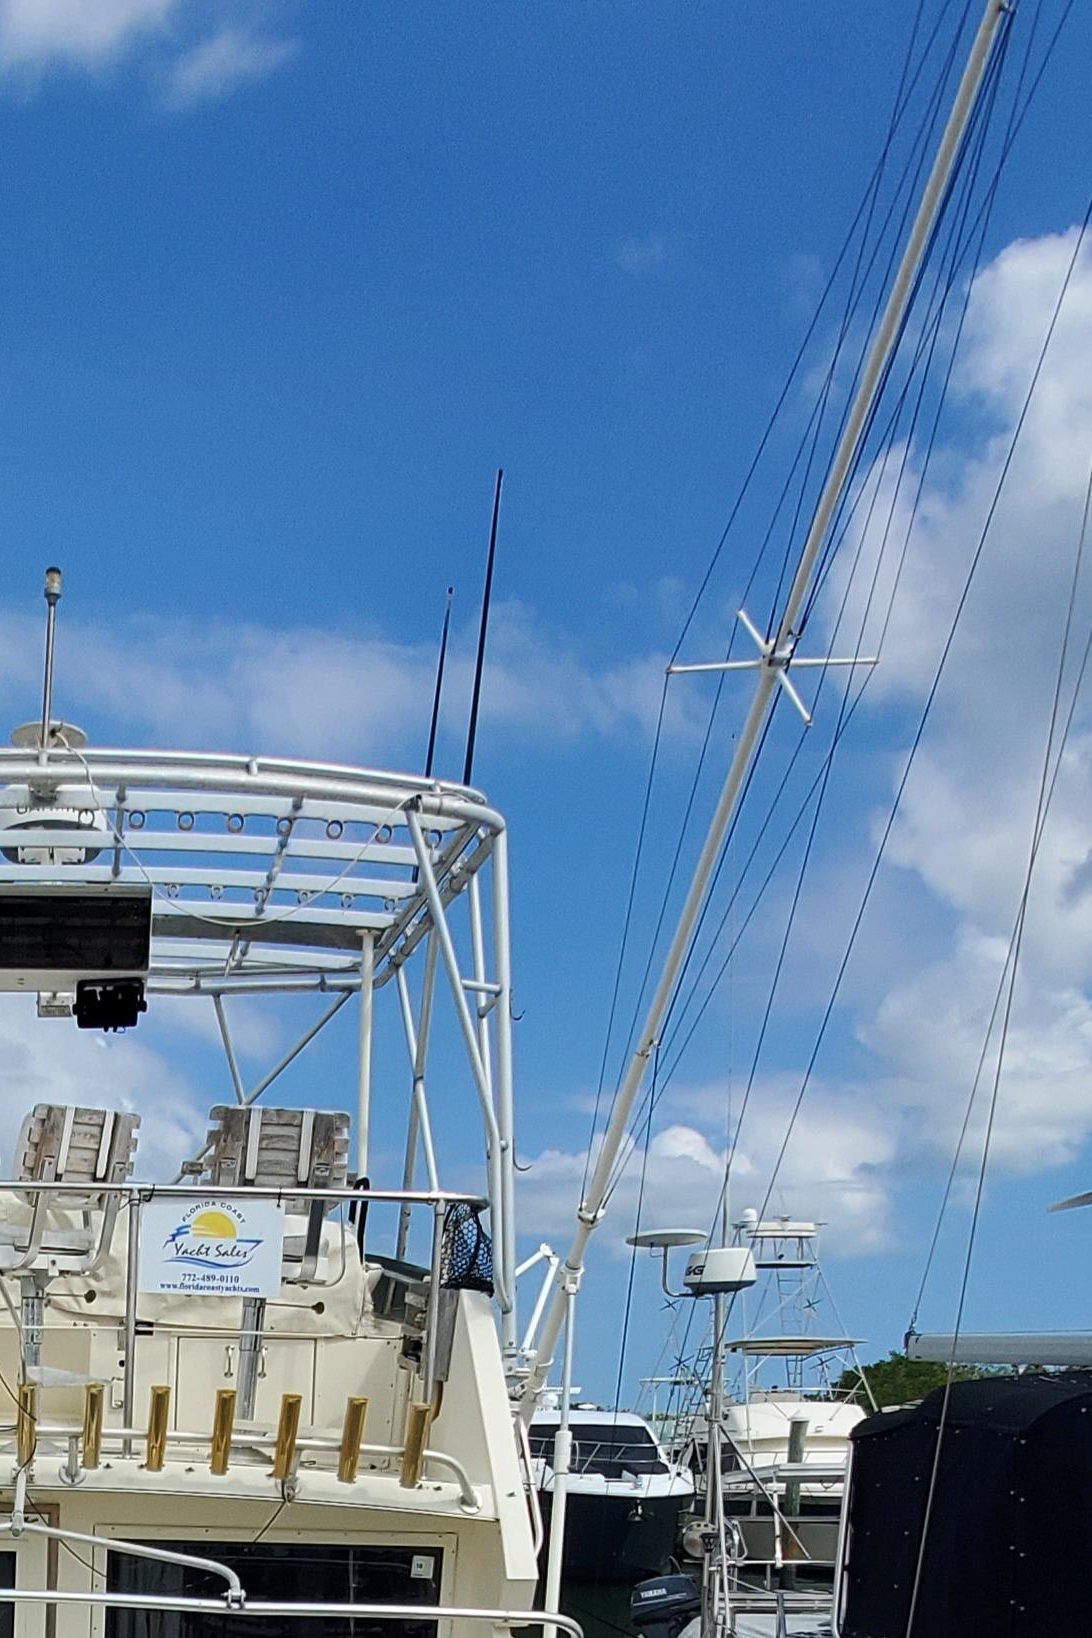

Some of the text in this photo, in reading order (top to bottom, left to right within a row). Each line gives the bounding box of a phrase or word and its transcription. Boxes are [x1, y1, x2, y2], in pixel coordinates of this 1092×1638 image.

[181, 1201, 246, 1224] FLORIDA COAST
[174, 1242, 248, 1259] Yacht Sales
[181, 1273, 240, 1284] 772-489-0110
